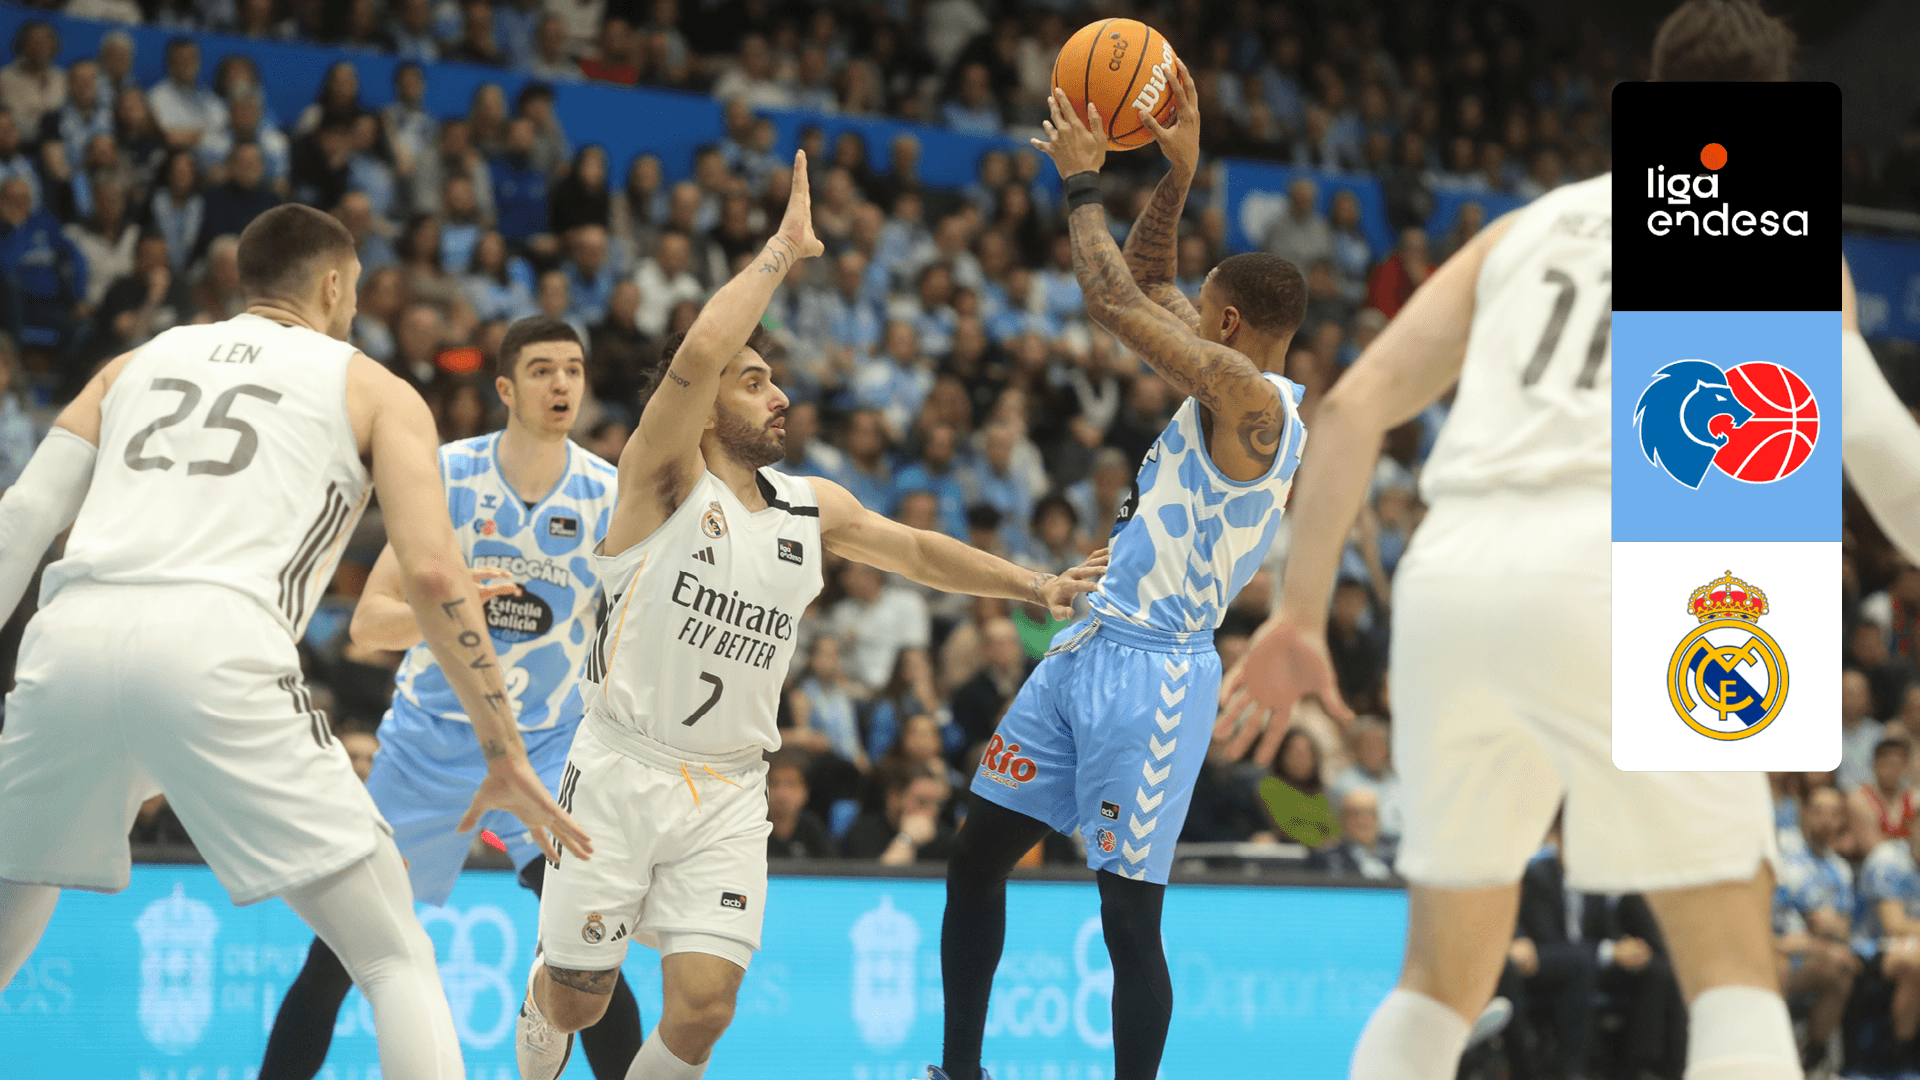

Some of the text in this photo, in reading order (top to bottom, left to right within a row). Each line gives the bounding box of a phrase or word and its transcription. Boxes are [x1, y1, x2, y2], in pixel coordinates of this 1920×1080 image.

[1109, 39, 1128, 71] acb
[208, 343, 263, 364] LEN
[123, 377, 283, 477] 25
[487, 610, 538, 631] Galicia
[488, 597, 543, 619] Estrella
[671, 570, 793, 641] Emirates
[678, 616, 777, 671] FLY BETTER
[681, 671, 724, 727] 7
[981, 733, 1037, 783] Río
[722, 898, 742, 908] acb
